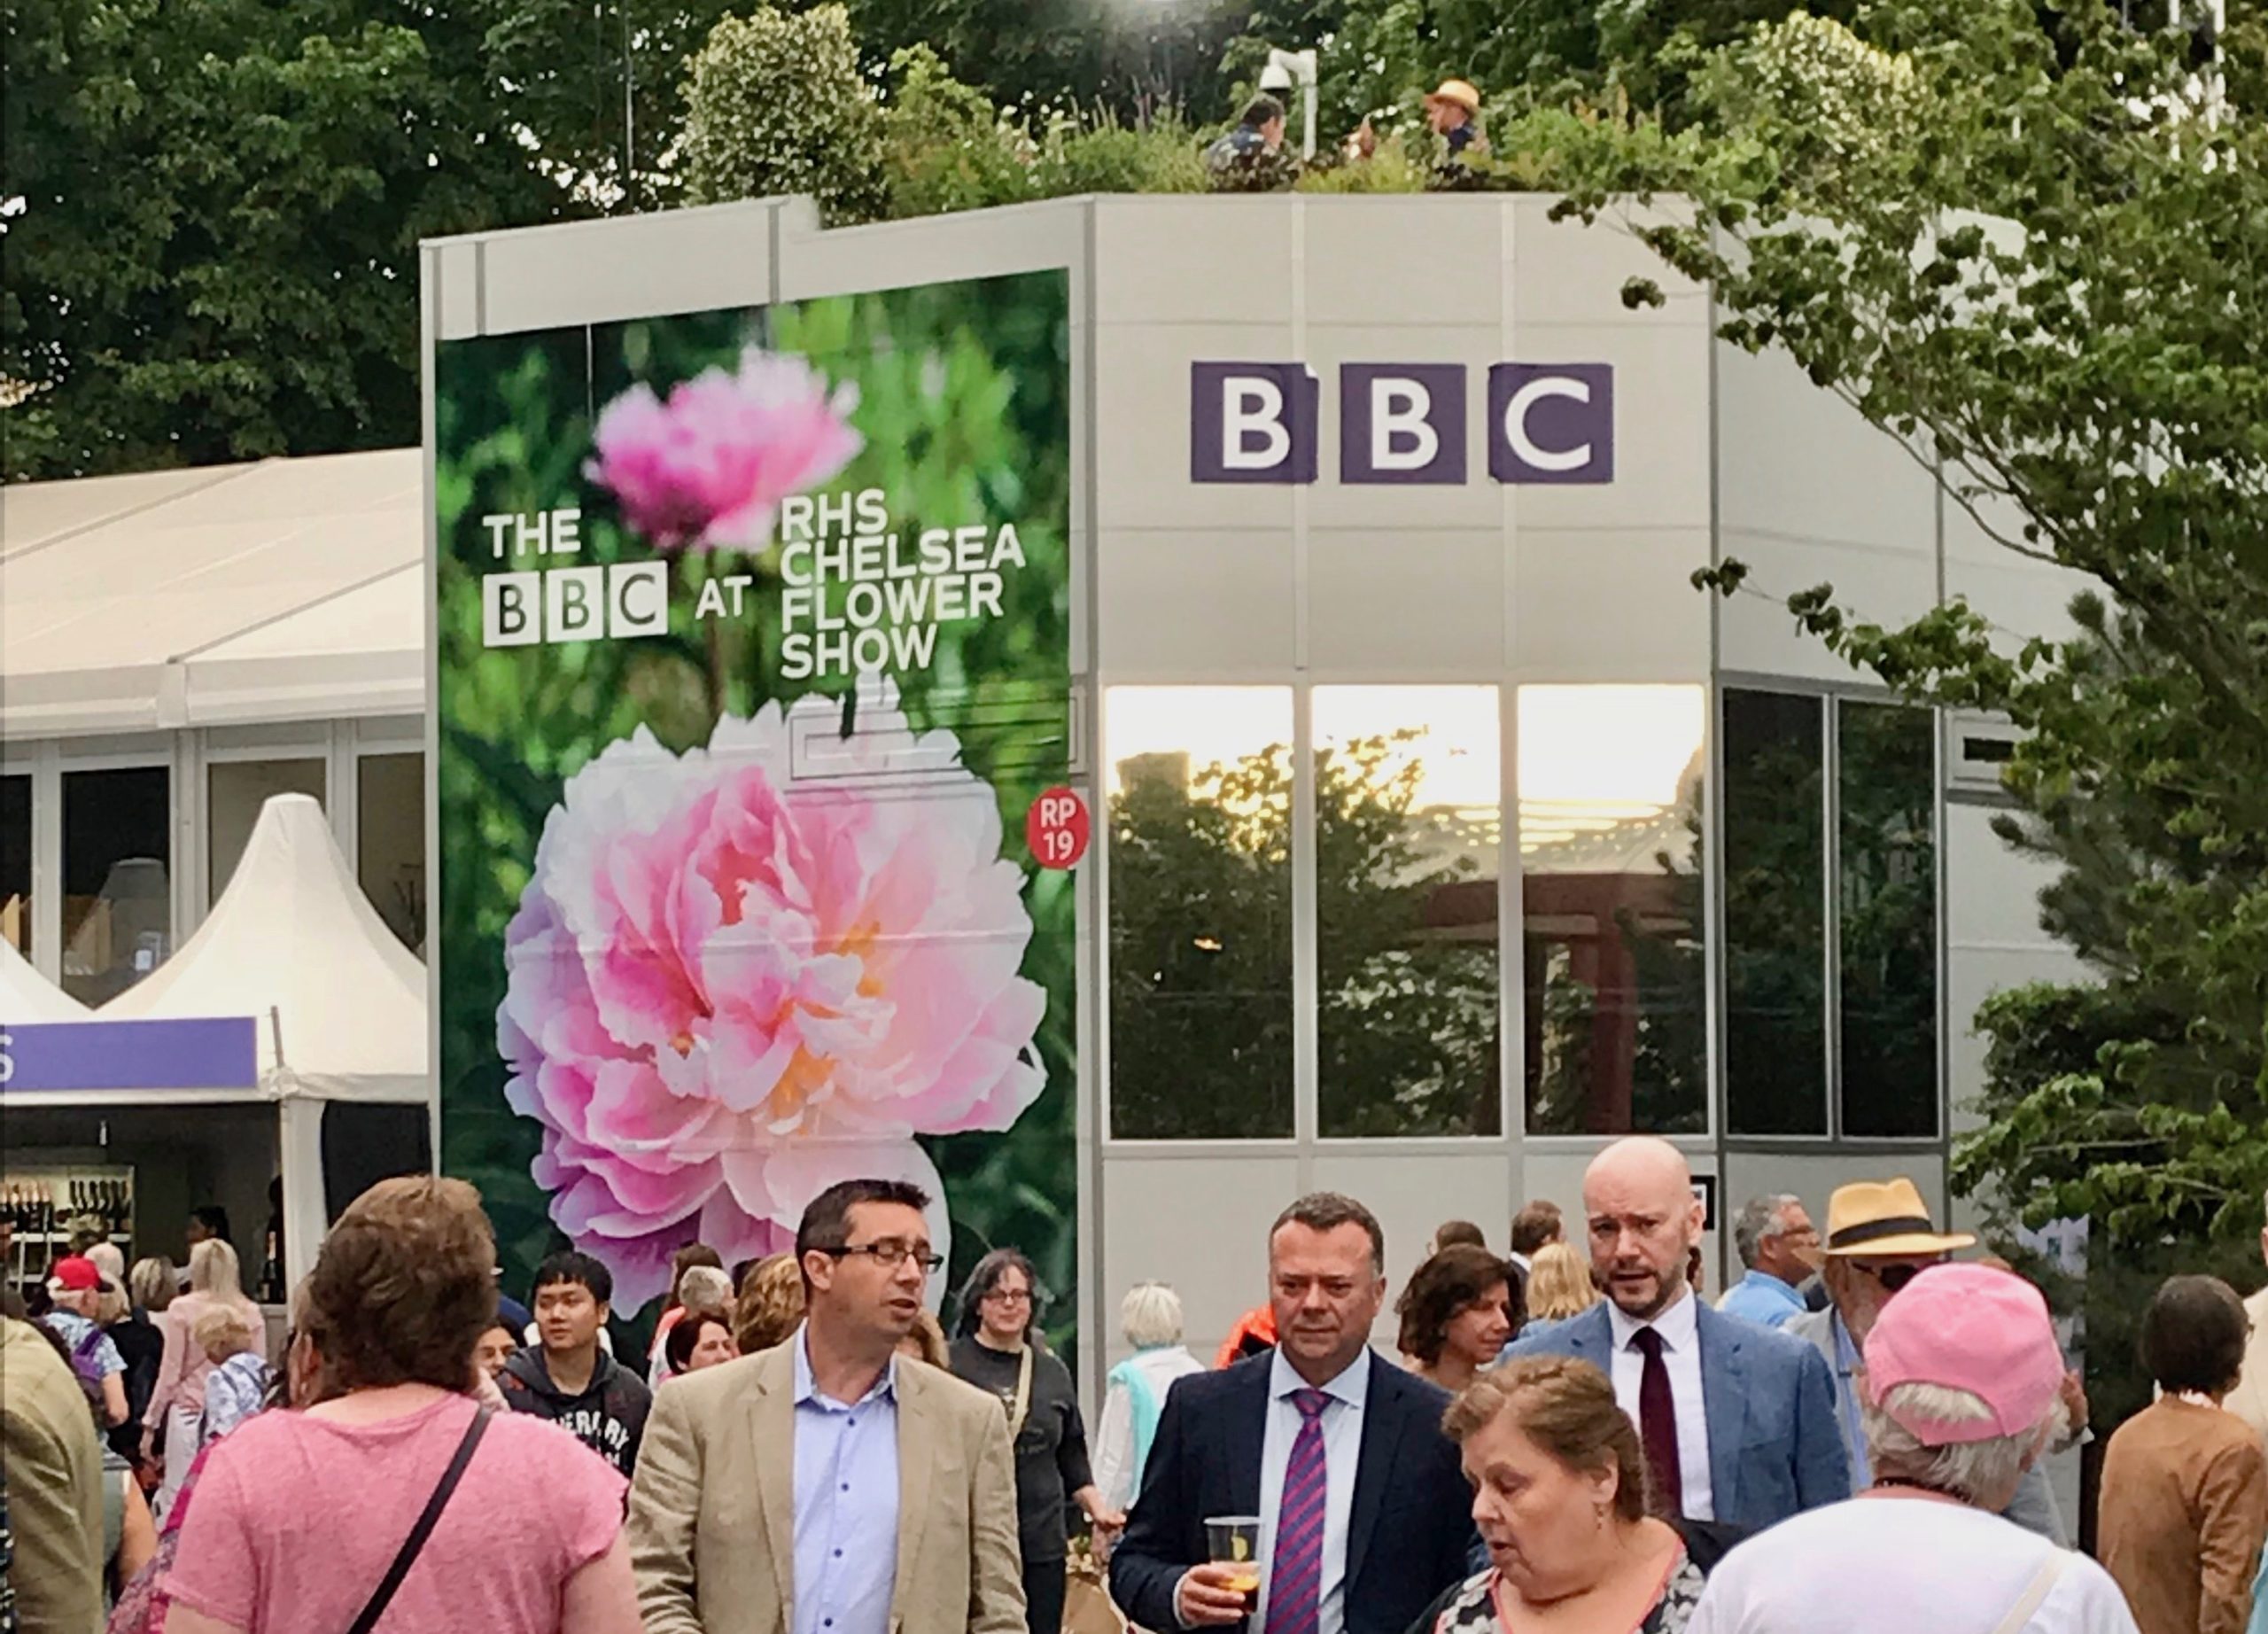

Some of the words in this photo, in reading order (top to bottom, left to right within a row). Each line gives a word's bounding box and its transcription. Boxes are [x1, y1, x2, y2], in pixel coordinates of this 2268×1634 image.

[1223, 377, 1591, 471] BBC
[483, 509, 581, 558] THE
[781, 488, 887, 541] RHS
[781, 523, 1026, 587] CHELSEA
[499, 572, 657, 634] BBC
[695, 575, 752, 619] AT
[781, 572, 1004, 633] FLOWER
[781, 624, 936, 679] SHOW
[1040, 798, 1077, 828] RP
[1042, 830, 1075, 860] 19
